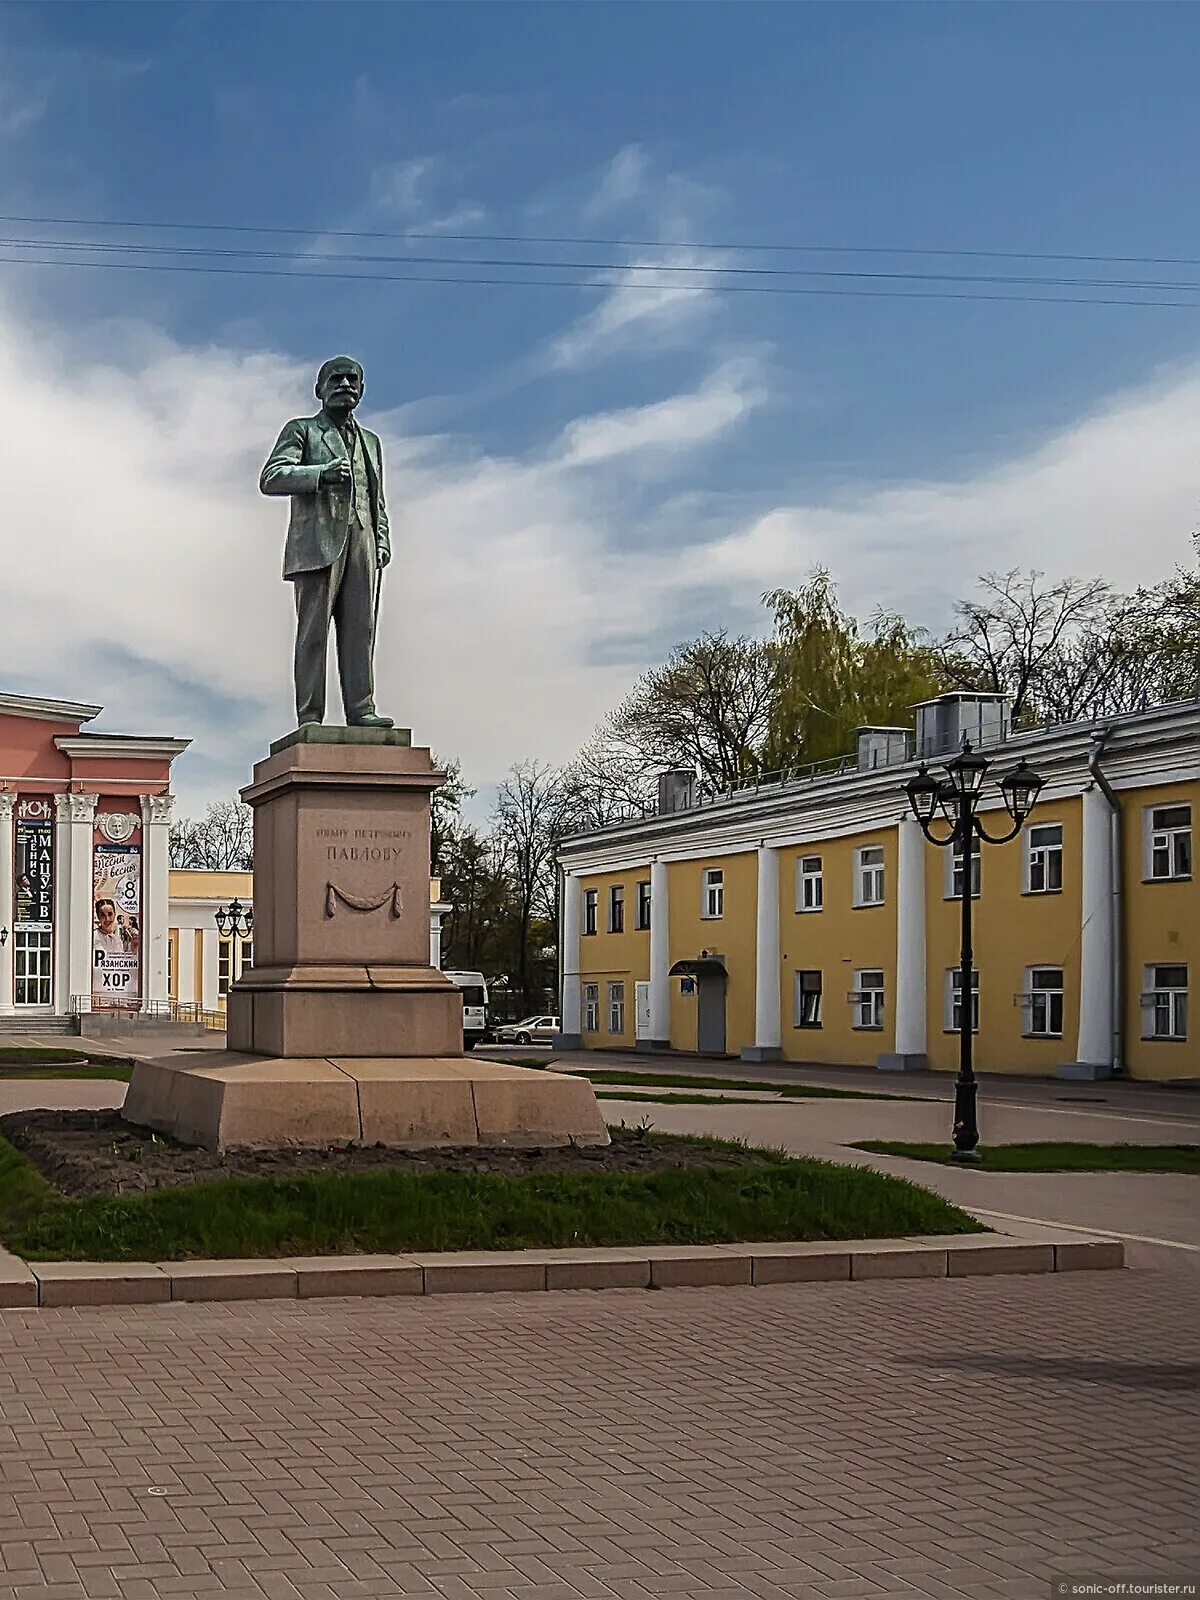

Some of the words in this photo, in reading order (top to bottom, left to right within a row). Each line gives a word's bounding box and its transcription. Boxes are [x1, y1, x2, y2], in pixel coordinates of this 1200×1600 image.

[30, 834, 38, 878] ДЕНИС
[326, 846, 401, 861] ПАВЛОВУ
[39, 834, 52, 918] МАЦУЕВ
[124, 881, 136, 900] 8
[102, 973, 131, 987] ХОР
